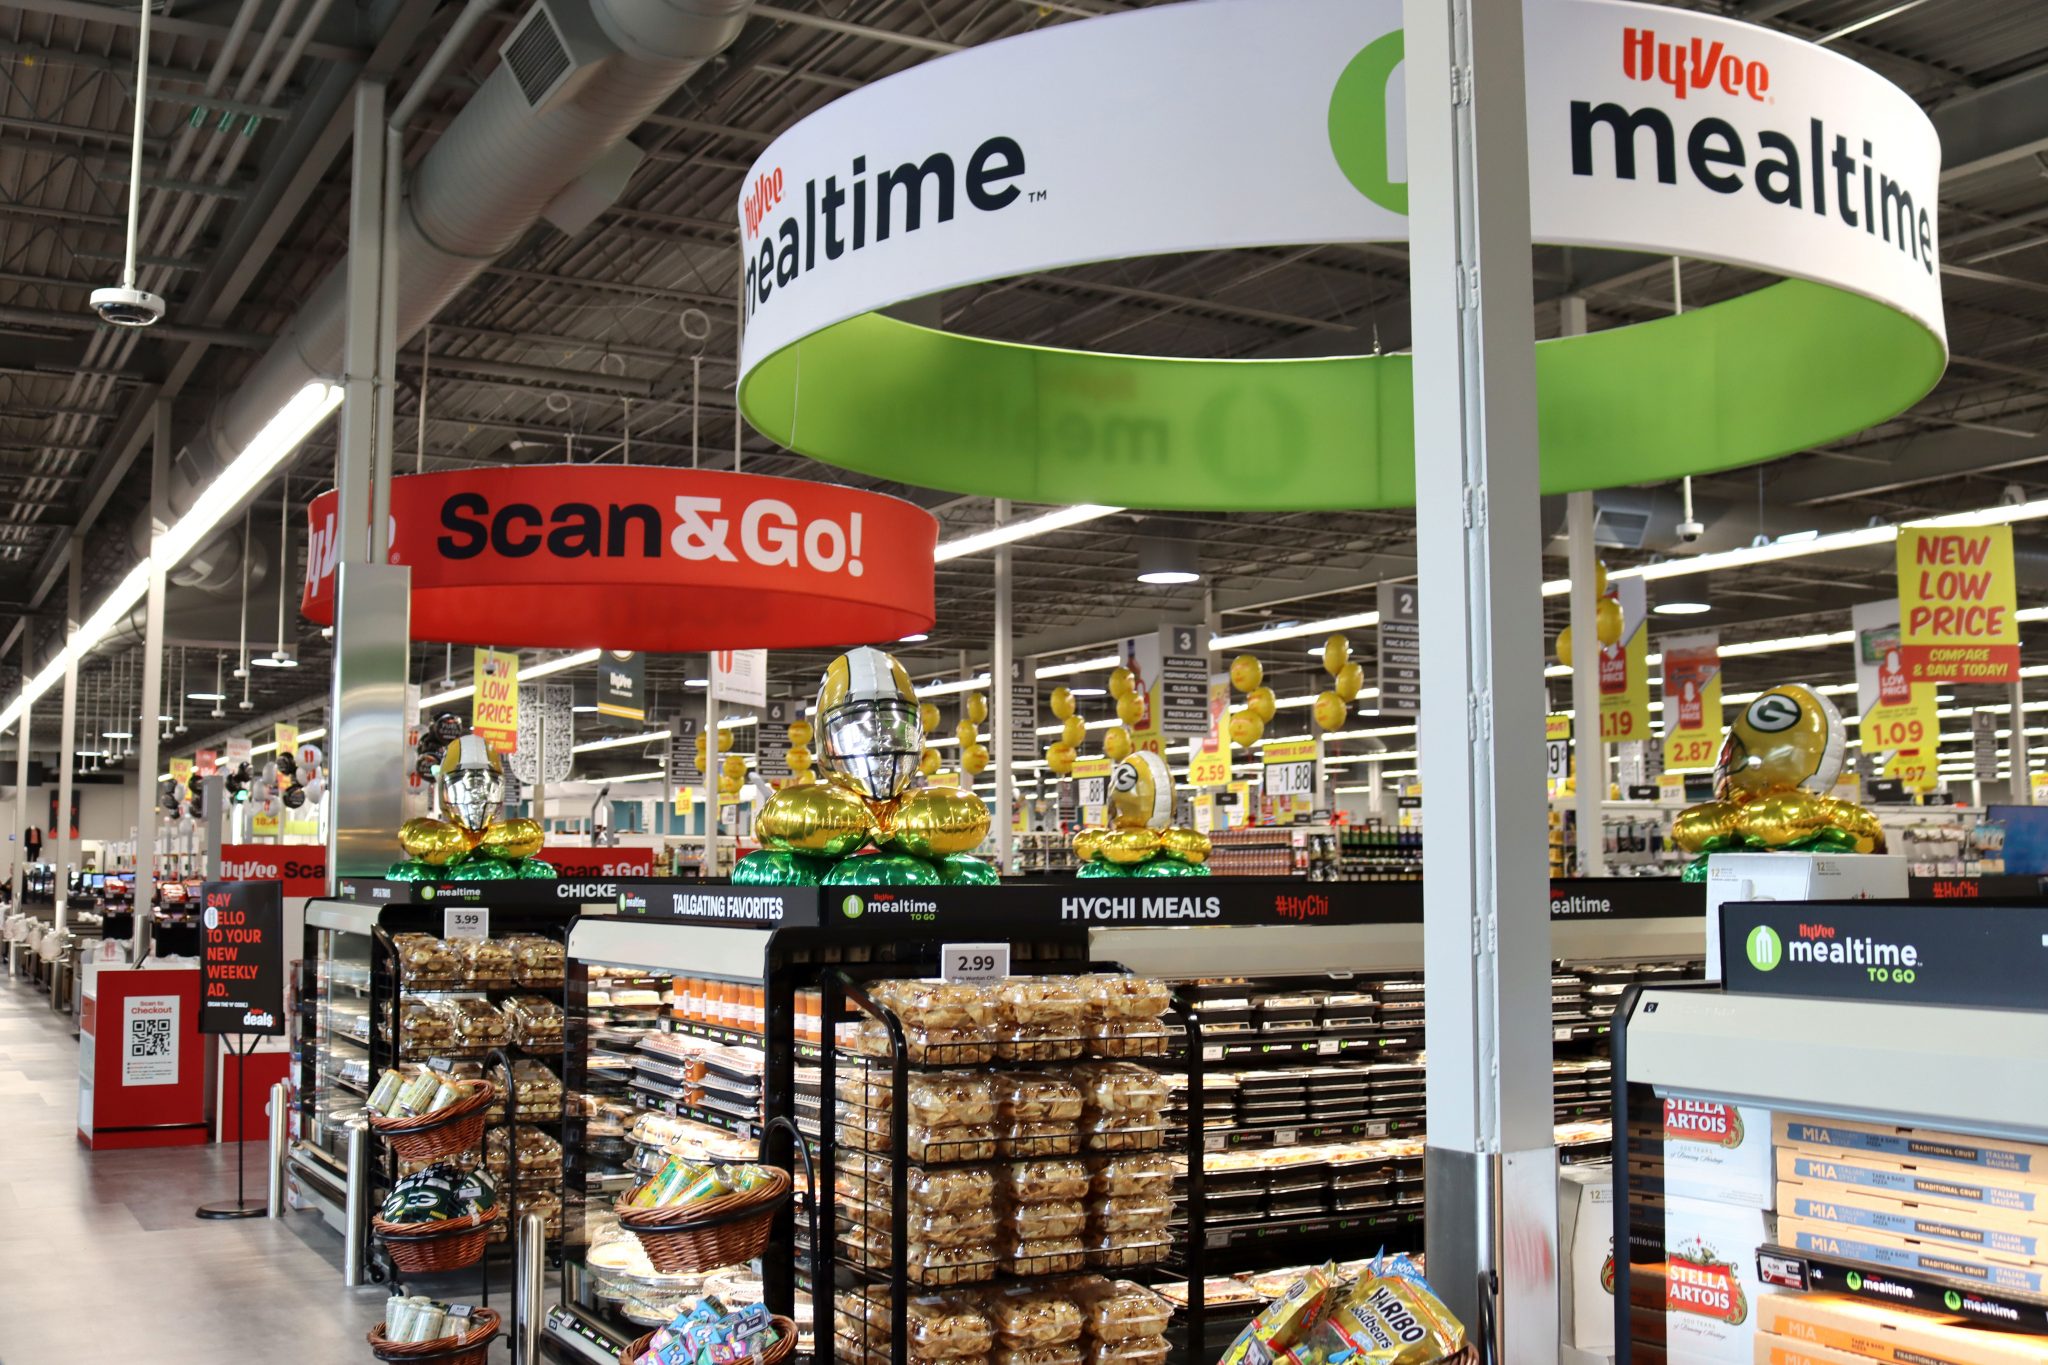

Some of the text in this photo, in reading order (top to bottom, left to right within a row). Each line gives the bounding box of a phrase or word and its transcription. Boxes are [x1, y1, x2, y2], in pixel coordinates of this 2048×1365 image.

[1570, 100, 1933, 275] mealtime
[437, 491, 864, 578] Scan&Go!
[1916, 534, 1991, 566] NEW
[1919, 570, 1992, 601] LOW
[1401, 593, 1413, 614] 2
[1909, 605, 2006, 637] PRICE
[1180, 633, 1192, 650] 3
[1929, 648, 1990, 662] COMPARE
[1602, 661, 1625, 673] LOW
[1912, 663, 2008, 677] & SAVE TODAY!
[1602, 671, 1625, 682] PRICE
[482, 678, 510, 700] LOW
[476, 702, 514, 724] PRICE
[771, 707, 781, 719] 6
[1680, 703, 1700, 712] LOW
[1681, 711, 1701, 721] PRICE
[684, 721, 692, 733] 7
[1872, 719, 1924, 746] 1.09
[1673, 741, 1713, 762] 2.87
[1197, 764, 1225, 782] 2.59
[437, 887, 481, 898] mealtime
[557, 883, 617, 898] CHICKE
[207, 893, 232, 907] SAY
[672, 894, 784, 920] TAILGATING FAVORITES
[867, 899, 937, 914] mealtime
[1061, 896, 1220, 920] HYCHI MEALS
[454, 914, 479, 925] 3.99
[910, 913, 936, 922] TO GO
[207, 929, 262, 943] TO YOUR
[207, 947, 238, 961] NEW
[1789, 937, 1918, 967] mealtime
[958, 955, 995, 971] 2.99
[207, 965, 259, 979] WEEKLY
[1868, 967, 1916, 984] TO GO
[207, 983, 230, 997] AD.
[1667, 1098, 1726, 1116] STELLA
[1666, 1112, 1727, 1134] ARTOIS
[1802, 1126, 1831, 1143] MIA
[1911, 1143, 1976, 1159] TRADITIONAL CRUST
[1985, 1151, 2015, 1161] ITALIAN
[1809, 1163, 1838, 1179] MIA
[1986, 1158, 2020, 1170] SAUSAGE
[1588, 1190, 1600, 1199] 12
[1917, 1181, 1981, 1198] TRADITIONAL CRUST
[1990, 1189, 2020, 1200] ITALIAN
[1809, 1203, 1838, 1220] MIA
[1991, 1198, 2025, 1210] SAUSAGE
[1917, 1223, 1982, 1240] TRADITIONAL CRUST
[1991, 1232, 2020, 1244] ITALIAN
[1811, 1237, 1840, 1254] MIA
[1992, 1242, 2026, 1253] SAUSAGE
[1920, 1258, 1986, 1276] TRADITIONAL CRUST
[1995, 1268, 2025, 1280] ITALIAN
[1670, 1265, 1729, 1291] STELLA
[1996, 1278, 2030, 1289] SAUSAGE
[1863, 1279, 1914, 1298] mealtime
[1670, 1284, 1730, 1310] ARTOIS
[1367, 1287, 1424, 1343] HARIBO
[1963, 1299, 2019, 1320] mealtime
[1788, 1322, 1817, 1339] MIA
